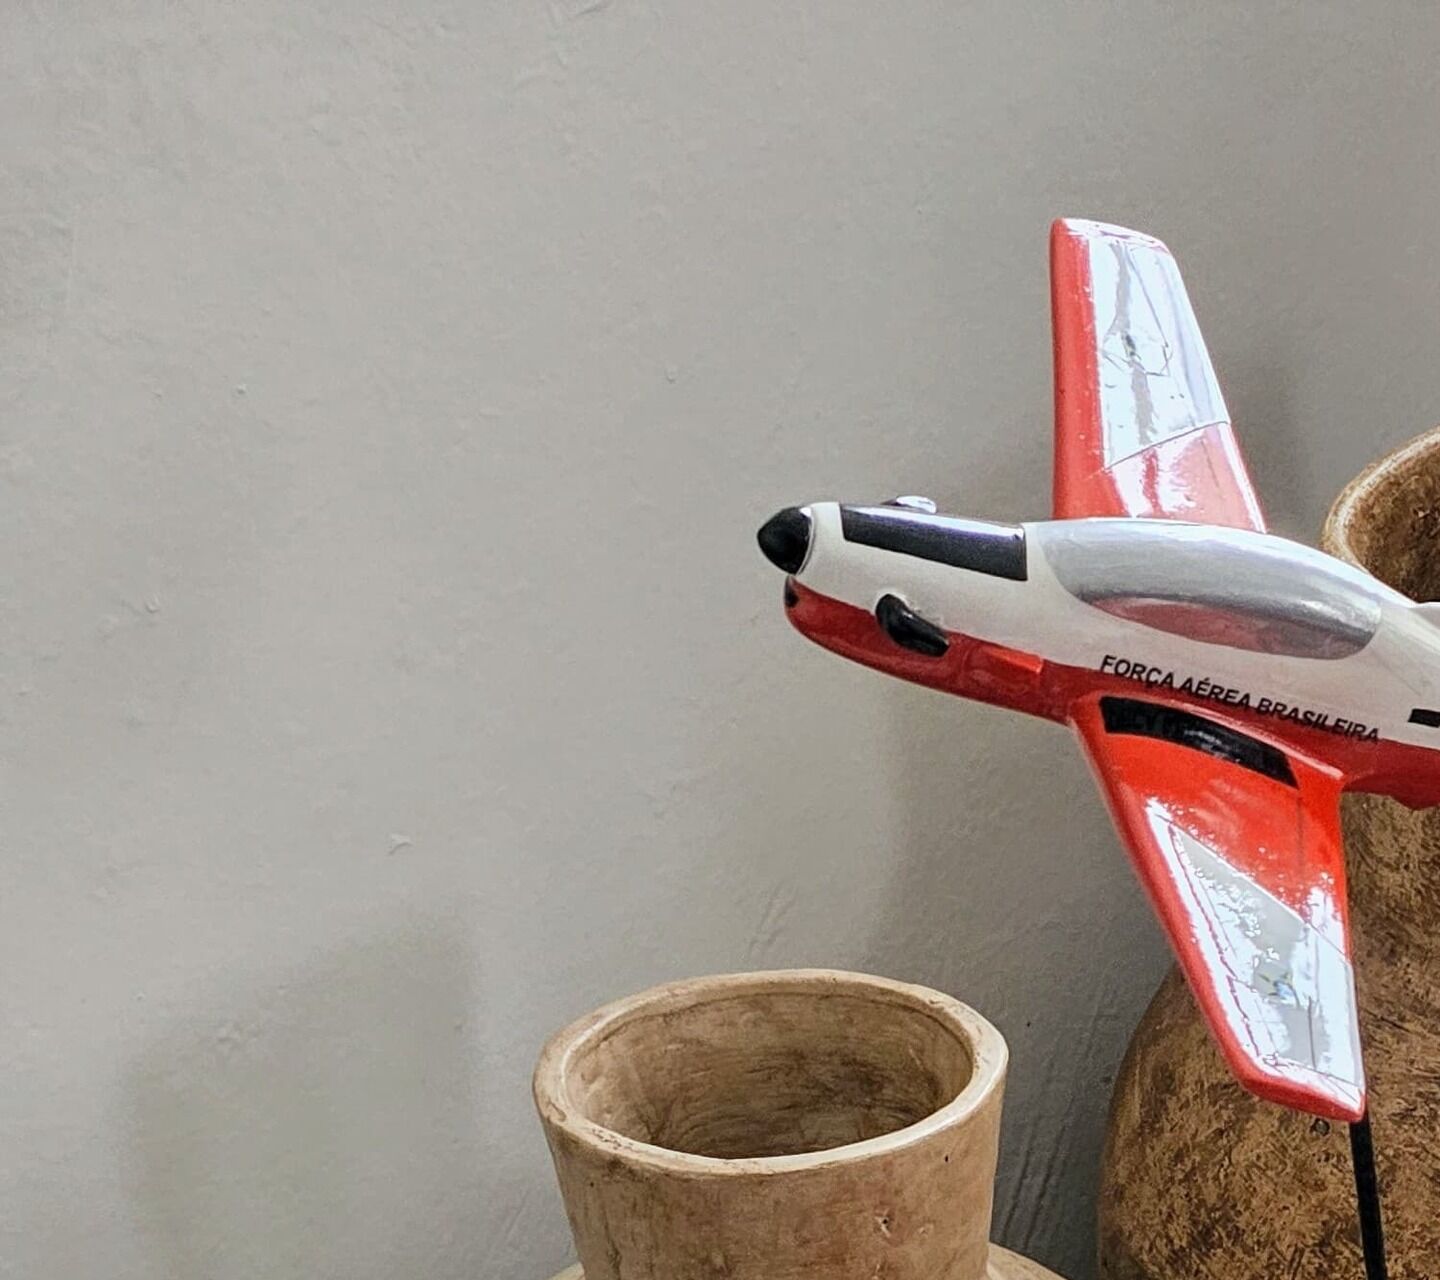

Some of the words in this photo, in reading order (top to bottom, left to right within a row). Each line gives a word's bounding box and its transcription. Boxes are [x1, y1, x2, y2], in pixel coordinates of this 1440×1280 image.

[1100, 653, 1176, 690] FORÇA
[1180, 677, 1252, 711] AÉREA
[1257, 697, 1380, 744] BRASILEIRA
